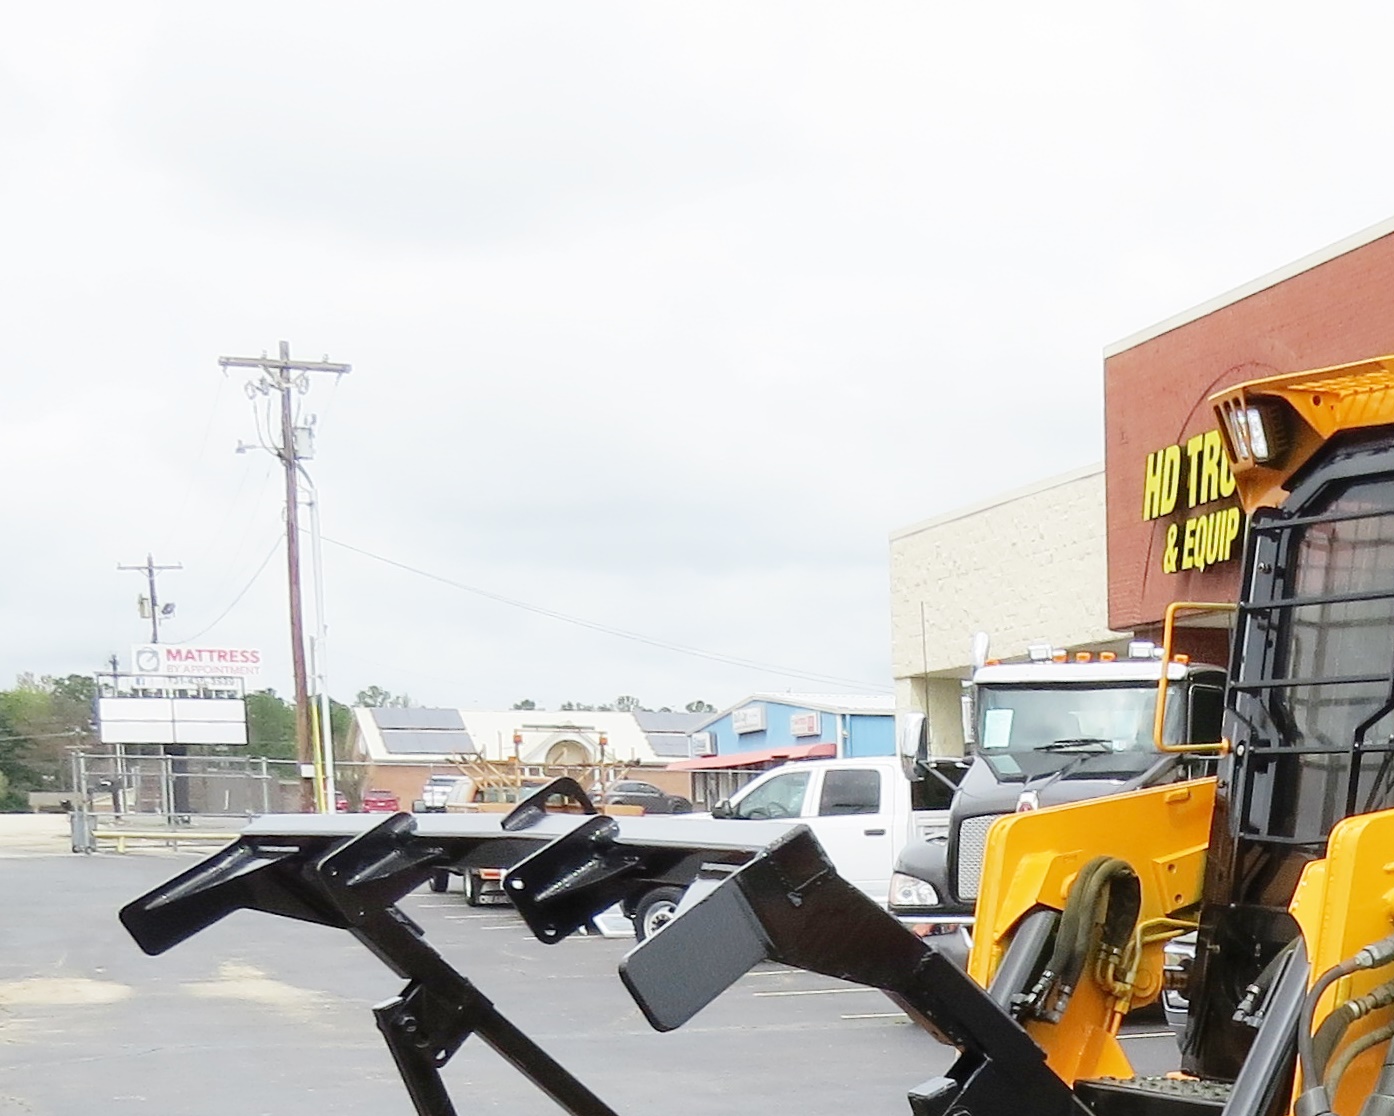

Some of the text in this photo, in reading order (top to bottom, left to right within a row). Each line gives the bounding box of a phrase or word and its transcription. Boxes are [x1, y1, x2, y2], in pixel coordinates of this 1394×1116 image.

[1143, 429, 1237, 522] HD TRU
[1163, 507, 1241, 574] & EQUIP
[165, 648, 260, 664] MATTRESS
[166, 664, 260, 676] BY APPOINTMENT
